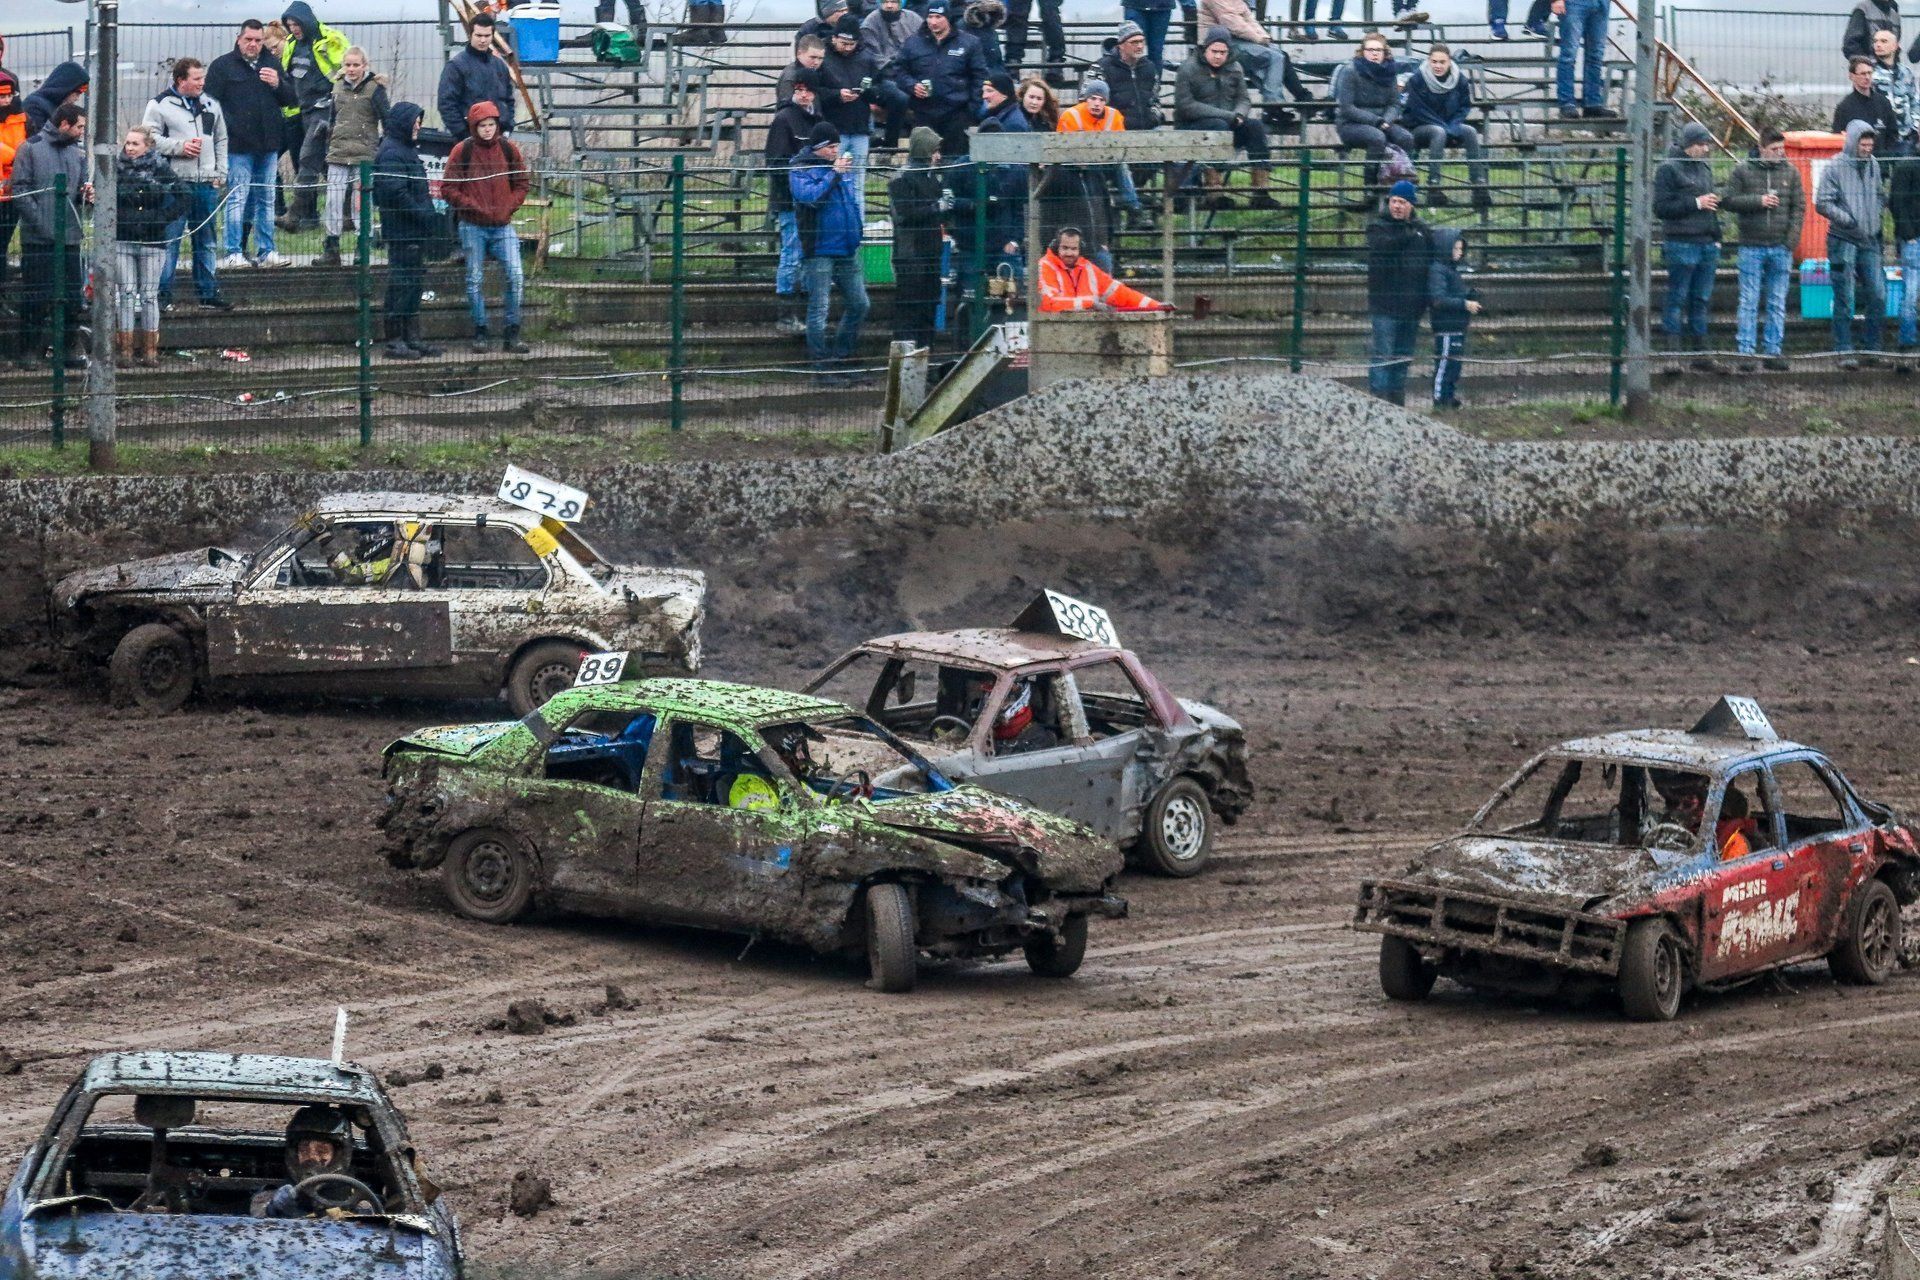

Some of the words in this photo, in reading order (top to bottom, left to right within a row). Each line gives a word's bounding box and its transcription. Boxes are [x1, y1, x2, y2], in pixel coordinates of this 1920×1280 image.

[510, 482, 580, 519] 878
[1049, 595, 1111, 645] 388
[580, 657, 621, 682] 89
